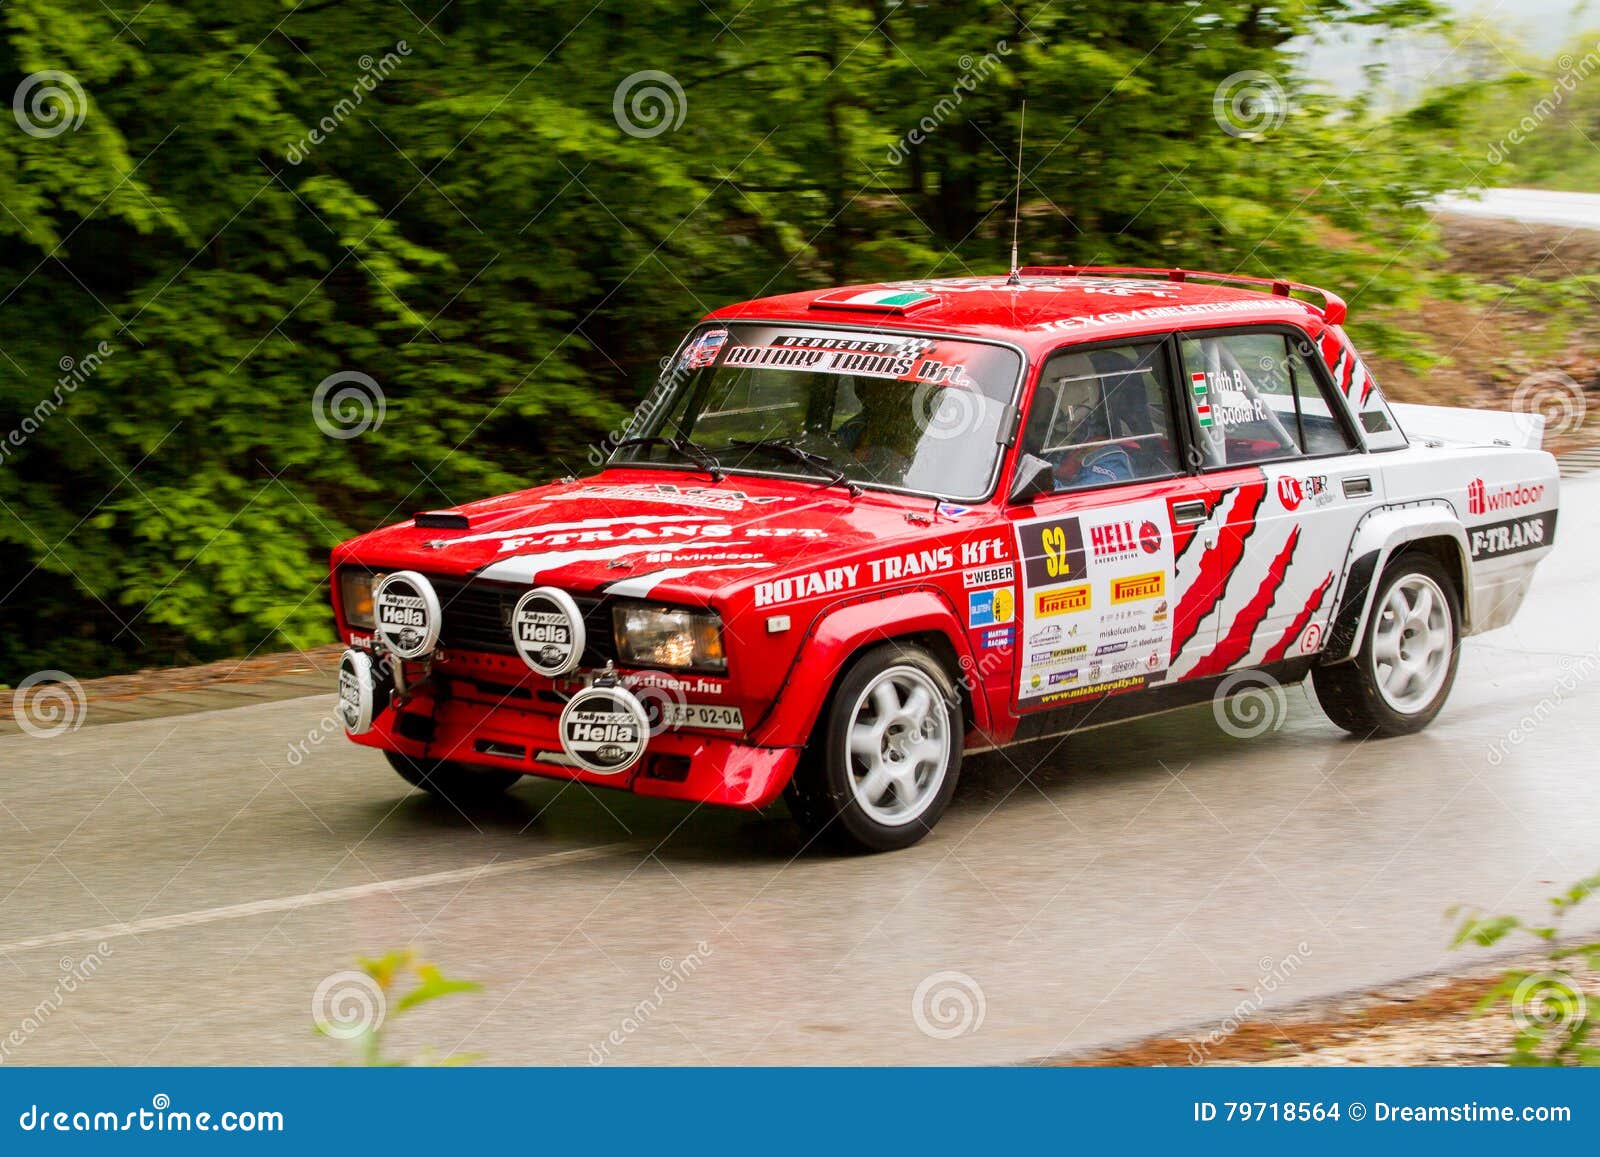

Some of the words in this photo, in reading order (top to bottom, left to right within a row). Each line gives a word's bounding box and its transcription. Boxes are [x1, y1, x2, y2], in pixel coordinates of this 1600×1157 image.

[724, 346, 823, 367] ROTARY
[829, 352, 913, 375] TRANS
[1233, 369, 1247, 391] B.
[1253, 398, 1268, 420] R.
[1487, 484, 1544, 511] windoor
[498, 524, 732, 552] F-TRANS
[745, 528, 829, 538] KFT.
[1090, 521, 1137, 556] HELL
[1471, 518, 1544, 556] F-TRANS
[1041, 526, 1070, 578] S2
[754, 564, 858, 607] ROTARY
[867, 546, 953, 581] TRANS
[961, 537, 1009, 565] Kft.
[974, 567, 1013, 583] WEBER
[1114, 576, 1161, 600] PIRELLI
[1039, 589, 1087, 613] PIRELLI
[383, 606, 424, 626] Hella
[522, 623, 567, 643] Hella
[699, 708, 741, 725] 02-04
[573, 723, 633, 742] Hella
